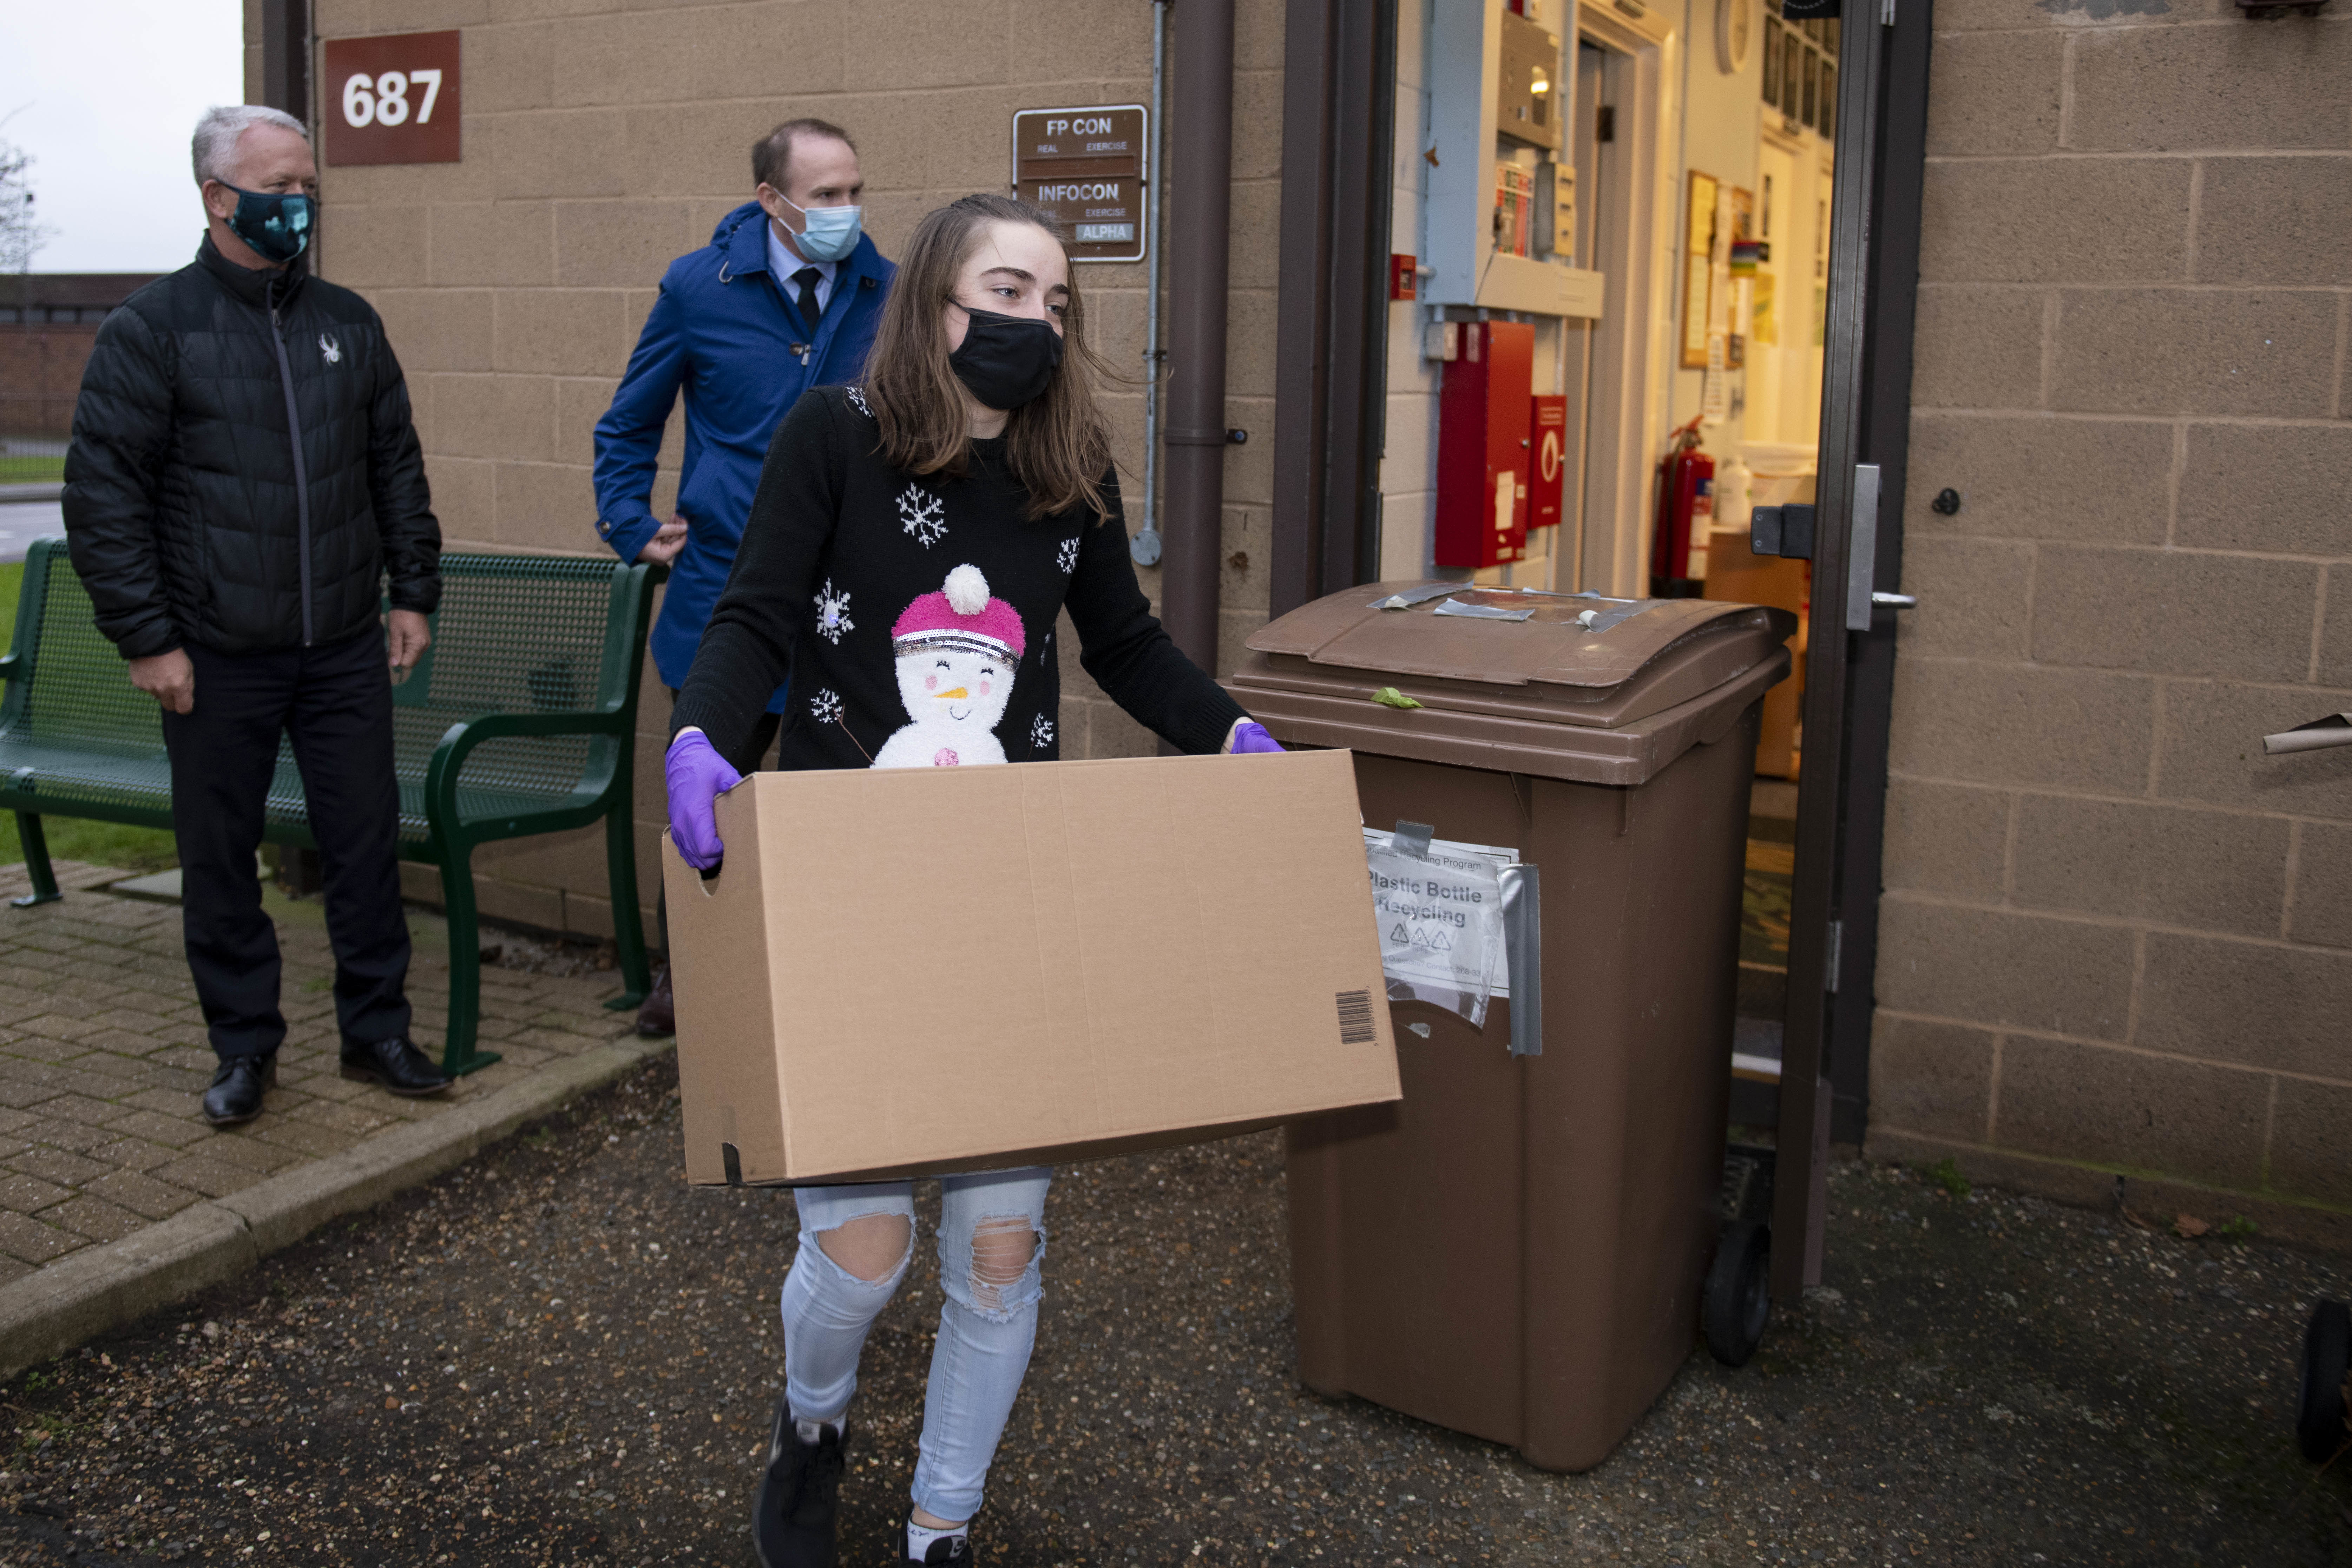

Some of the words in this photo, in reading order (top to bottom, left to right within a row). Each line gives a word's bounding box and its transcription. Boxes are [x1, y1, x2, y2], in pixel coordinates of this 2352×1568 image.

[343, 69, 442, 128] 687
[1047, 120, 1068, 136] FP
[1072, 118, 1112, 135] CON
[1037, 144, 1058, 153] REAL
[1086, 142, 1127, 151] EXERCISE
[1038, 183, 1119, 201] INFOCON
[1085, 208, 1126, 217] EXERCISE
[1083, 225, 1126, 239] ALPHA
[1443, 857, 1481, 870] Program
[1427, 882, 1482, 903] Bottle
[1378, 896, 1465, 928] Recycling
